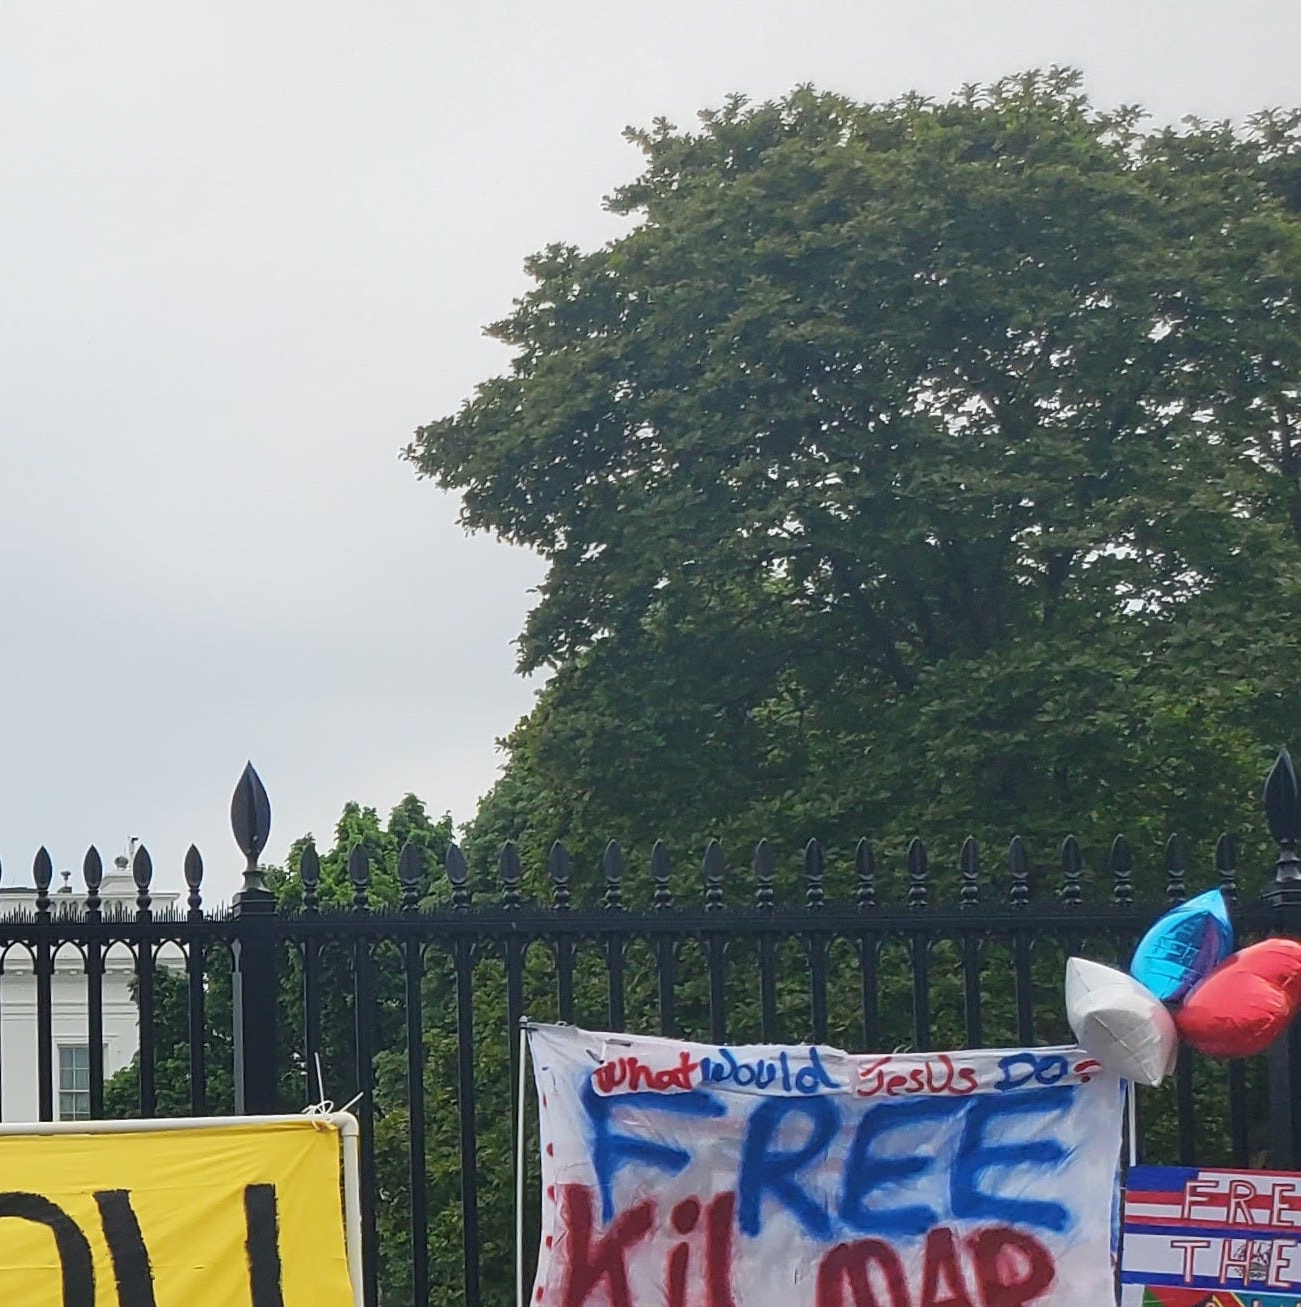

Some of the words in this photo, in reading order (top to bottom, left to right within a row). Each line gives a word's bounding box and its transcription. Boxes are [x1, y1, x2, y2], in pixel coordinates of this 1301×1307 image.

[580, 1086, 1076, 1240] FREE
[1182, 1179, 1296, 1227] FRE
[1170, 1238, 1299, 1288] THE
